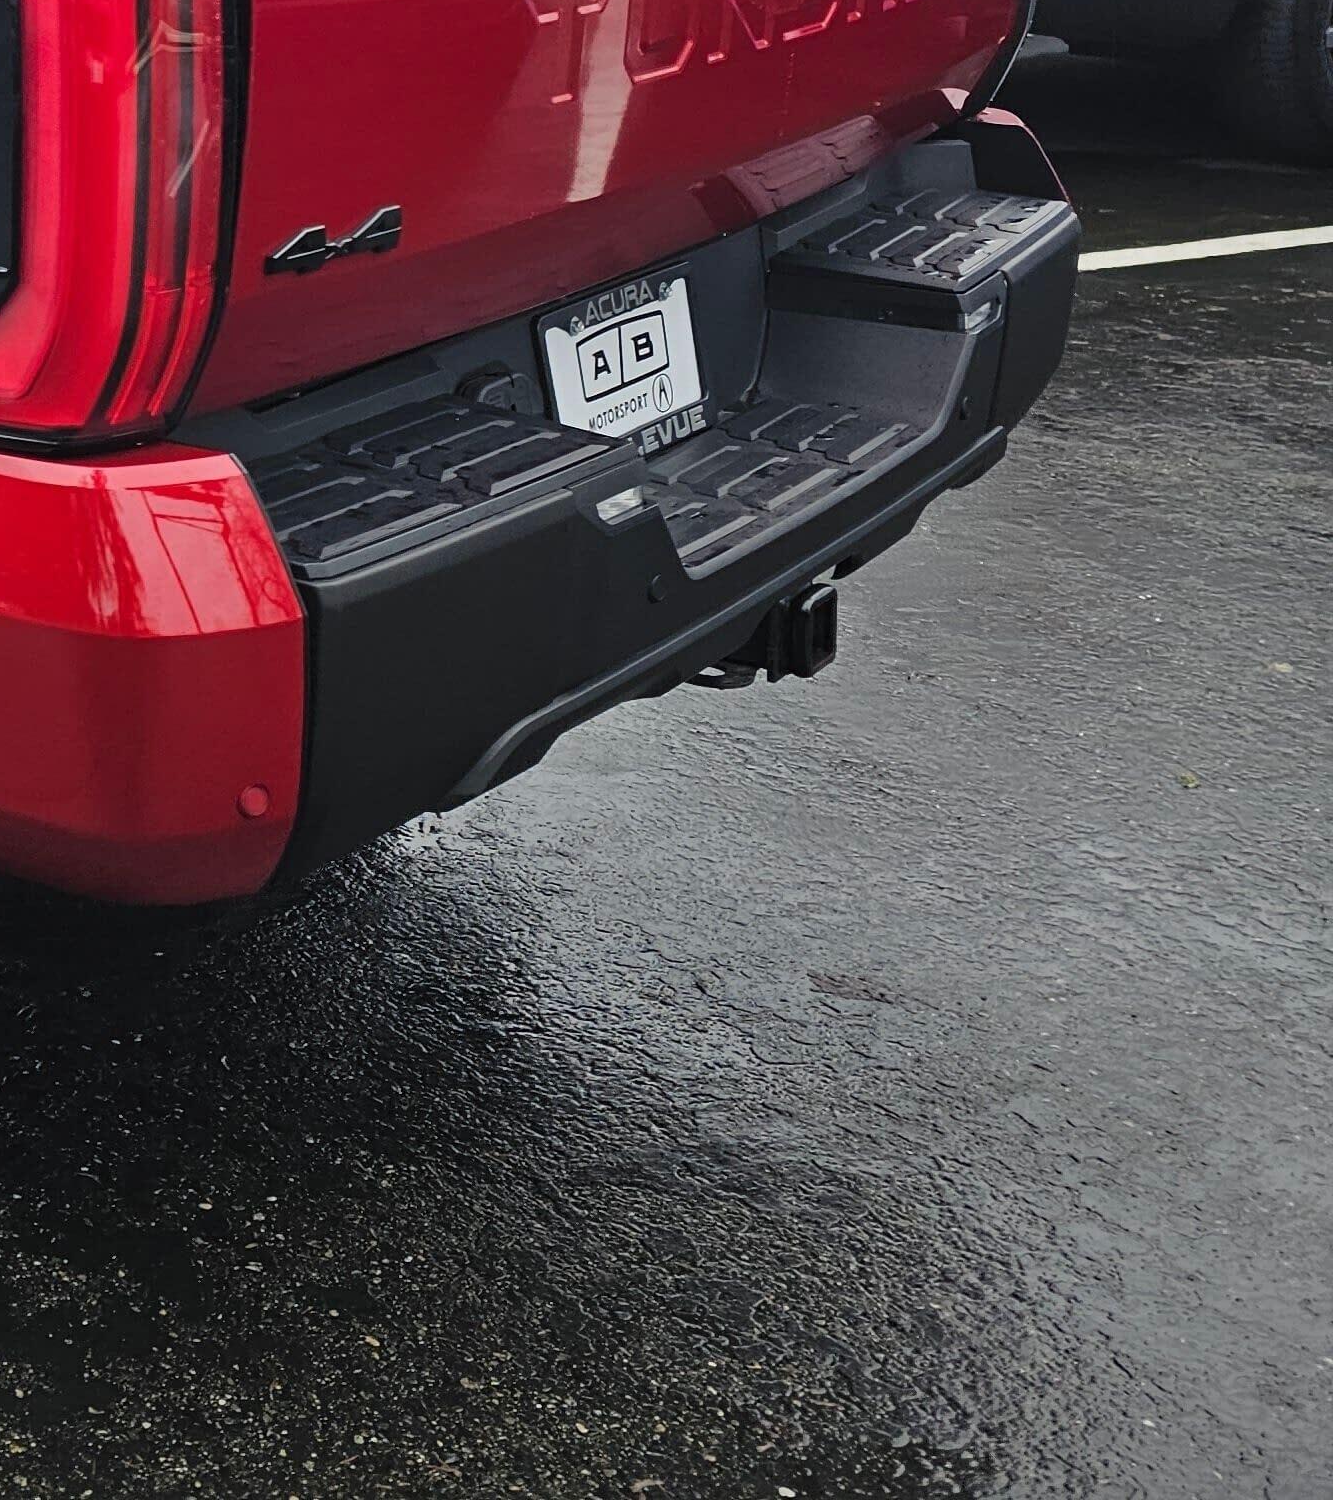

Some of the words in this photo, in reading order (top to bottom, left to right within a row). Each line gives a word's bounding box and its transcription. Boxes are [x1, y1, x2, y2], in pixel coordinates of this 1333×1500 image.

[585, 280, 655, 326] ACURA
[589, 392, 648, 430] MOTORSPORT
[638, 404, 707, 456] EVUE
